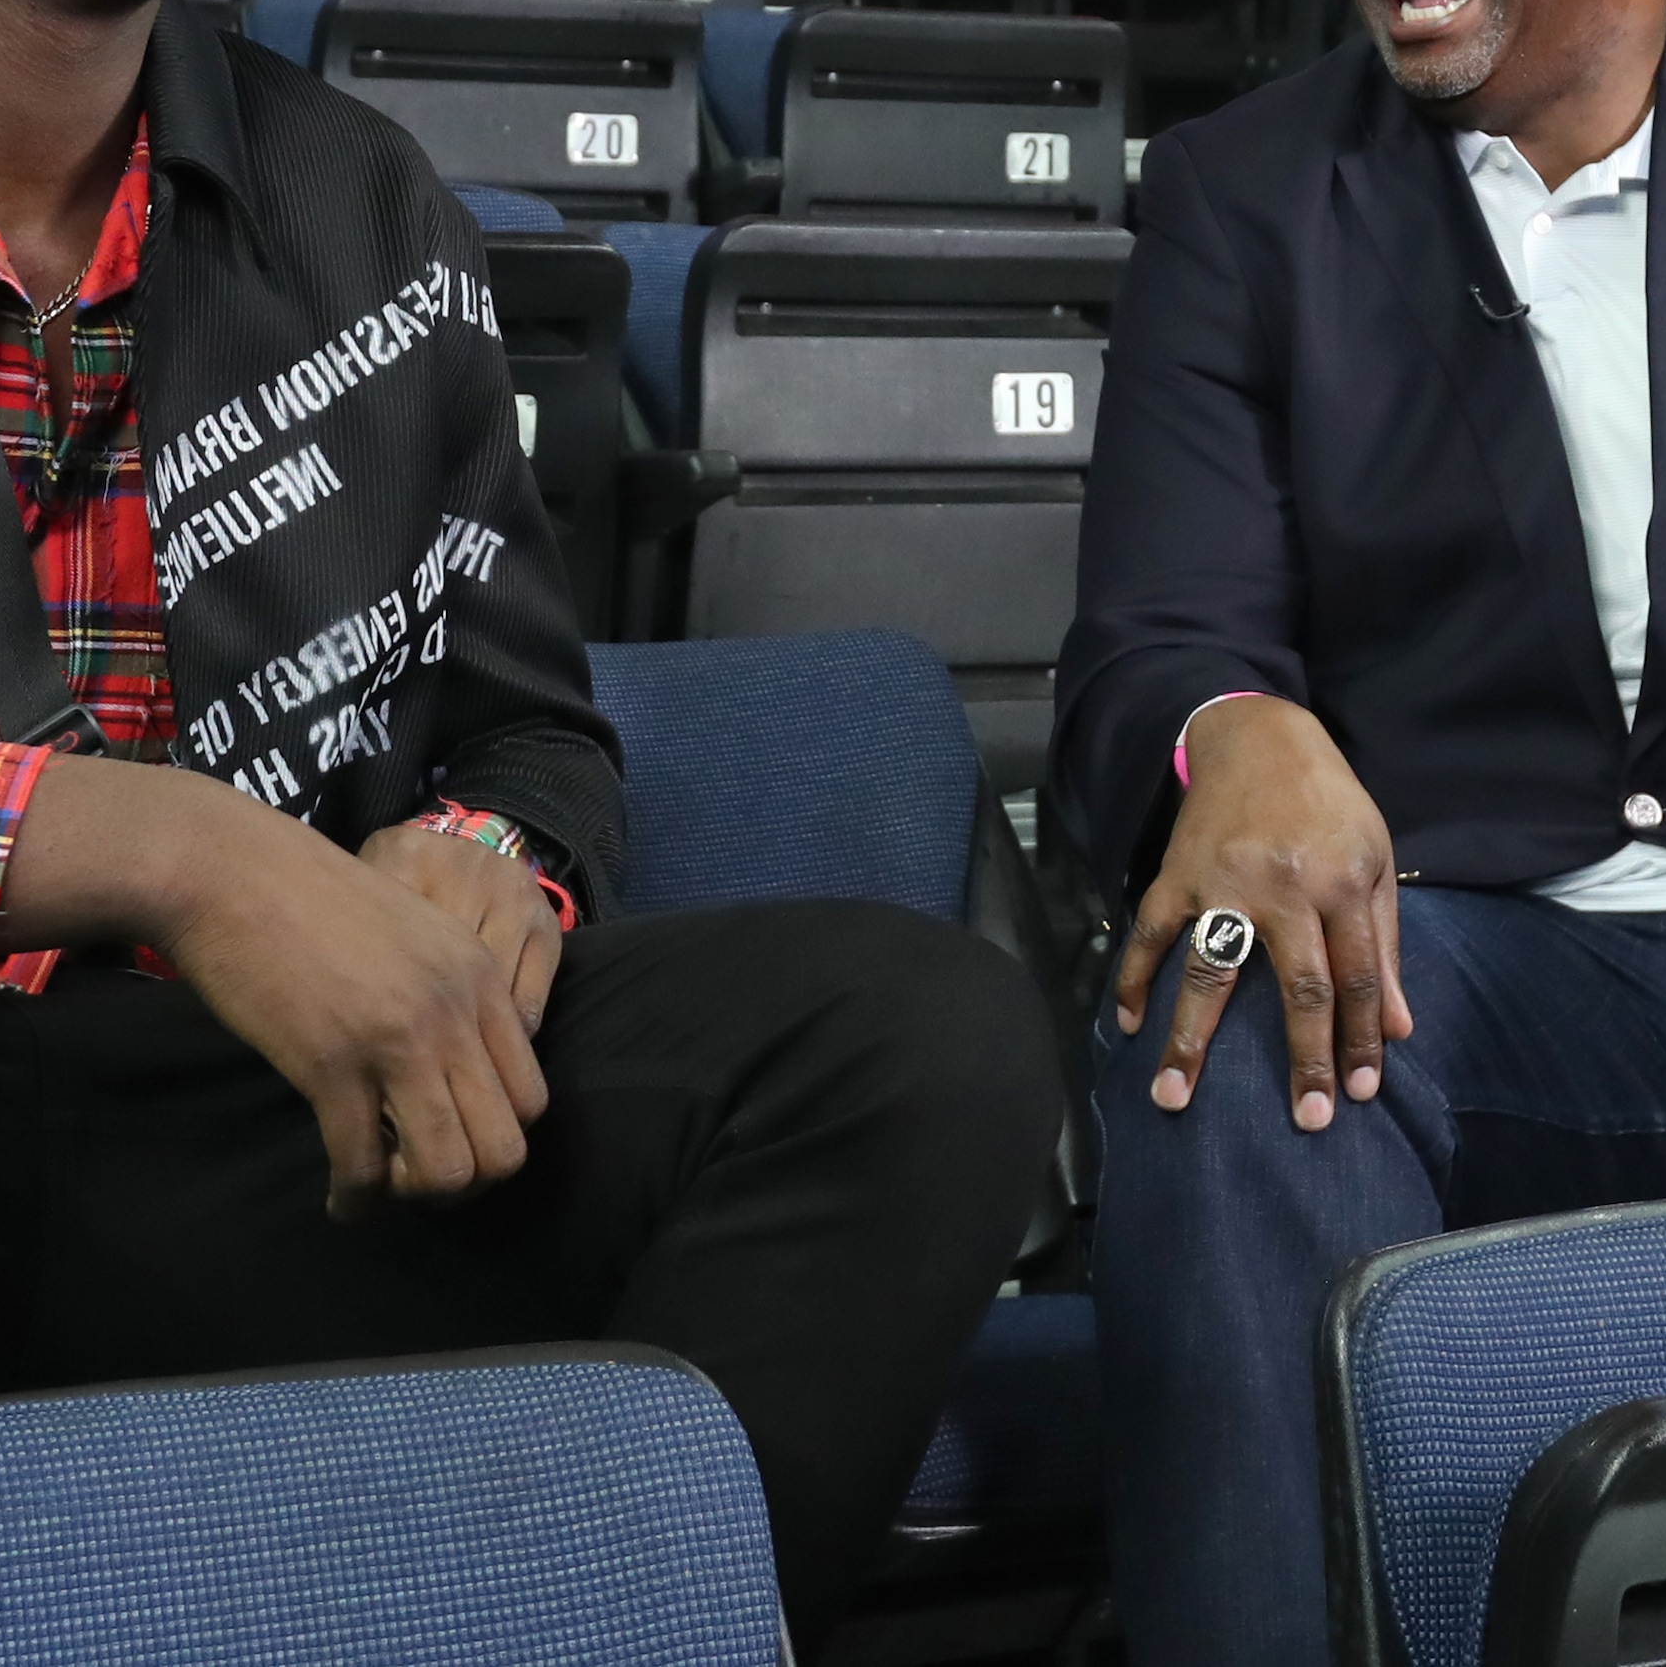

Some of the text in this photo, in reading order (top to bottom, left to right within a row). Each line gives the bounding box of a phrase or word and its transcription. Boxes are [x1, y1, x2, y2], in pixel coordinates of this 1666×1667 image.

[581, 119, 623, 160] 20
[1023, 139, 1055, 177] 21
[1008, 379, 1057, 429] 19
